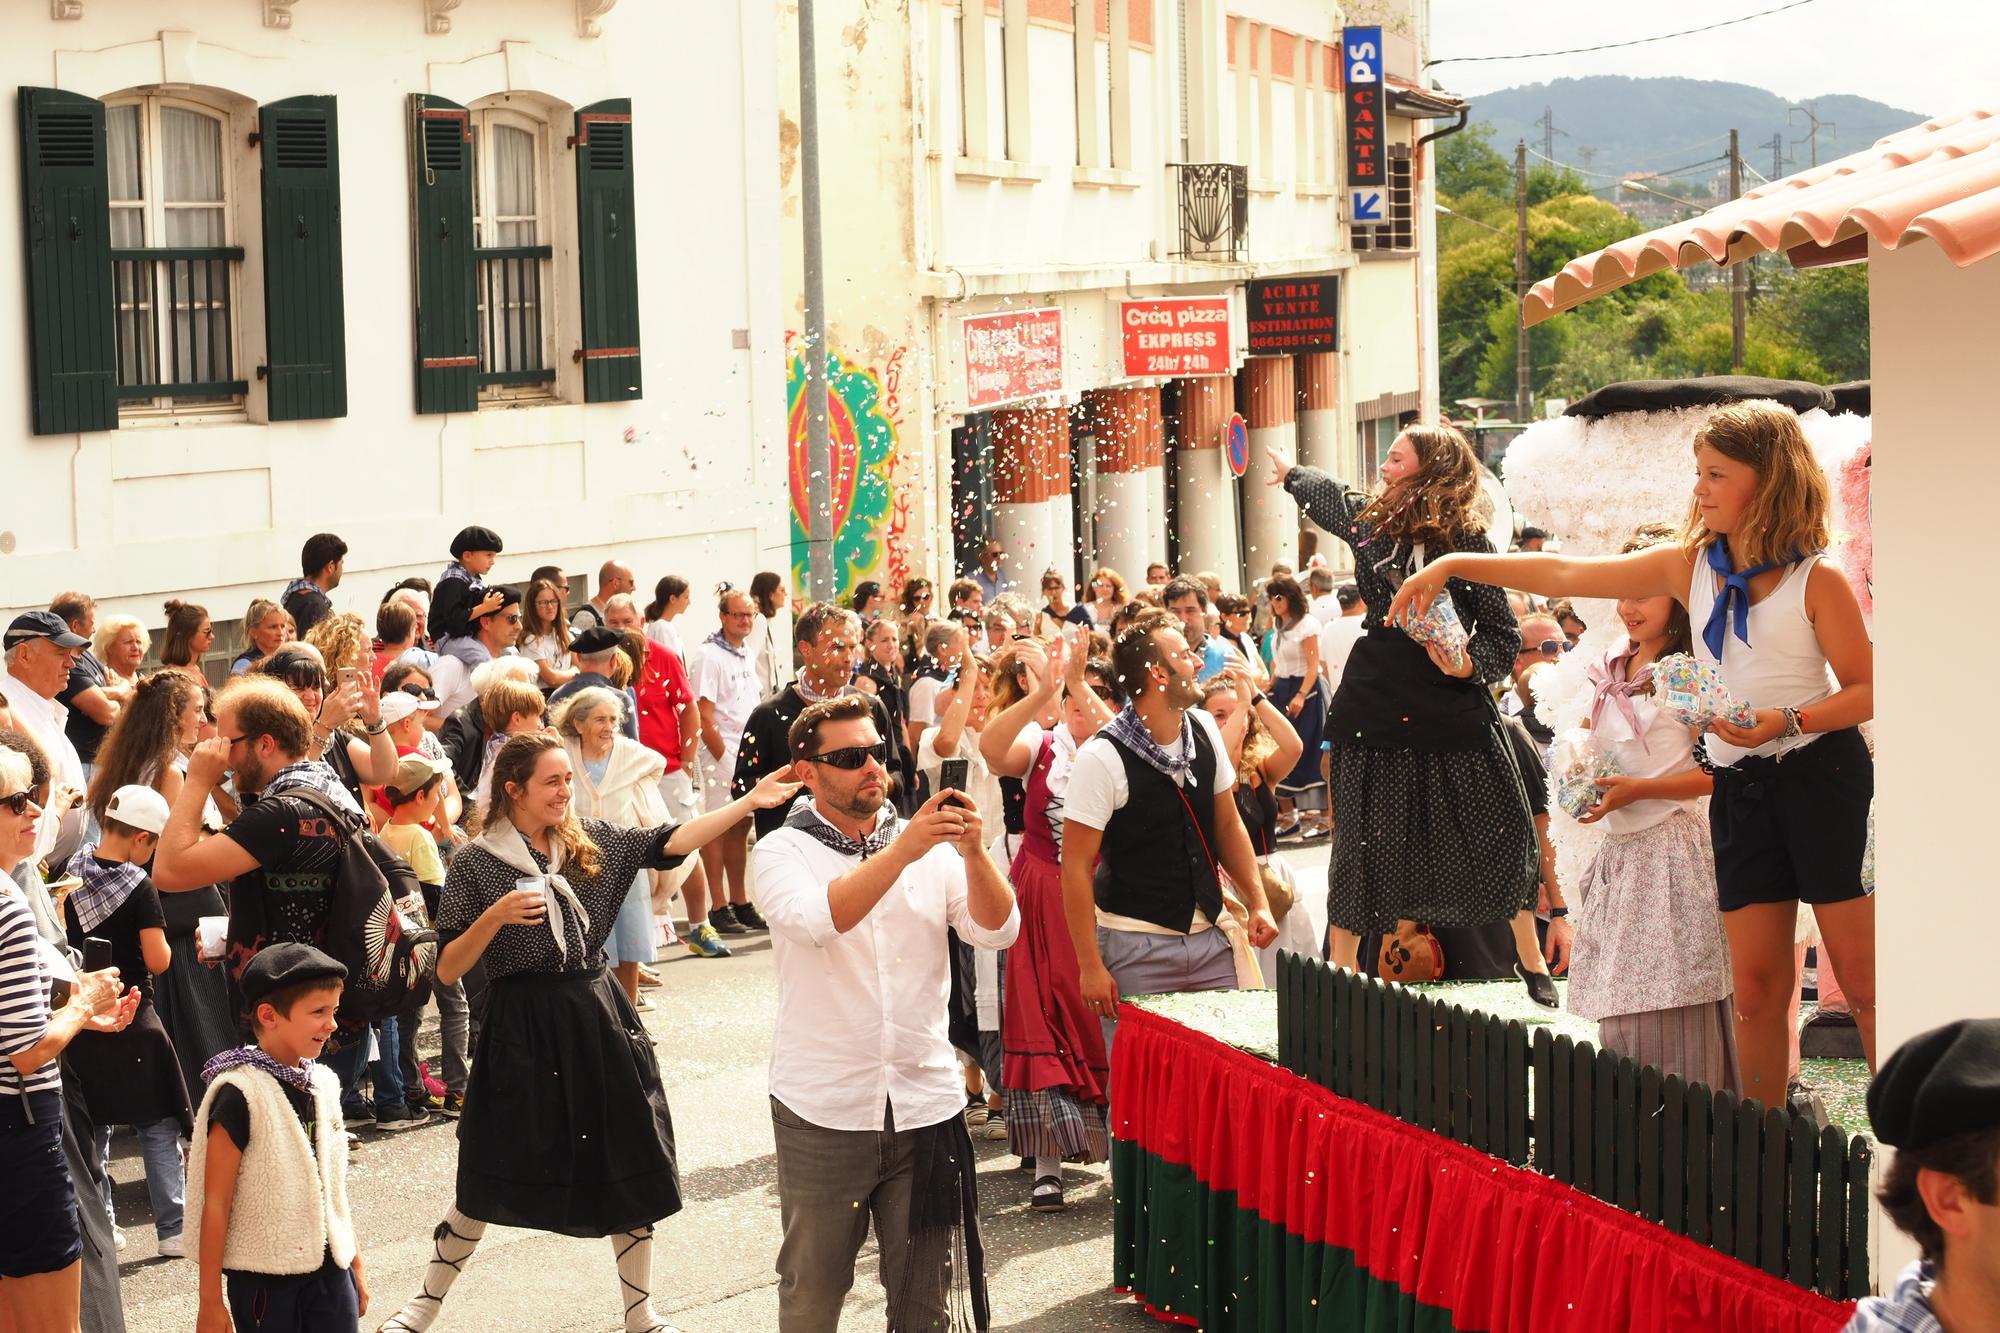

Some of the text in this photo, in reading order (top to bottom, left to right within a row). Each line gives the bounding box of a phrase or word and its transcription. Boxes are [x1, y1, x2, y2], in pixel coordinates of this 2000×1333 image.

[1262, 283, 1321, 299] ACHAT
[1126, 305, 1227, 328] Croq pizza
[1263, 300, 1320, 316] VENTE
[1249, 316, 1334, 334] ESTIMATION
[1138, 331, 1217, 349] EXPRESS
[1183, 354, 1210, 370] 24h
